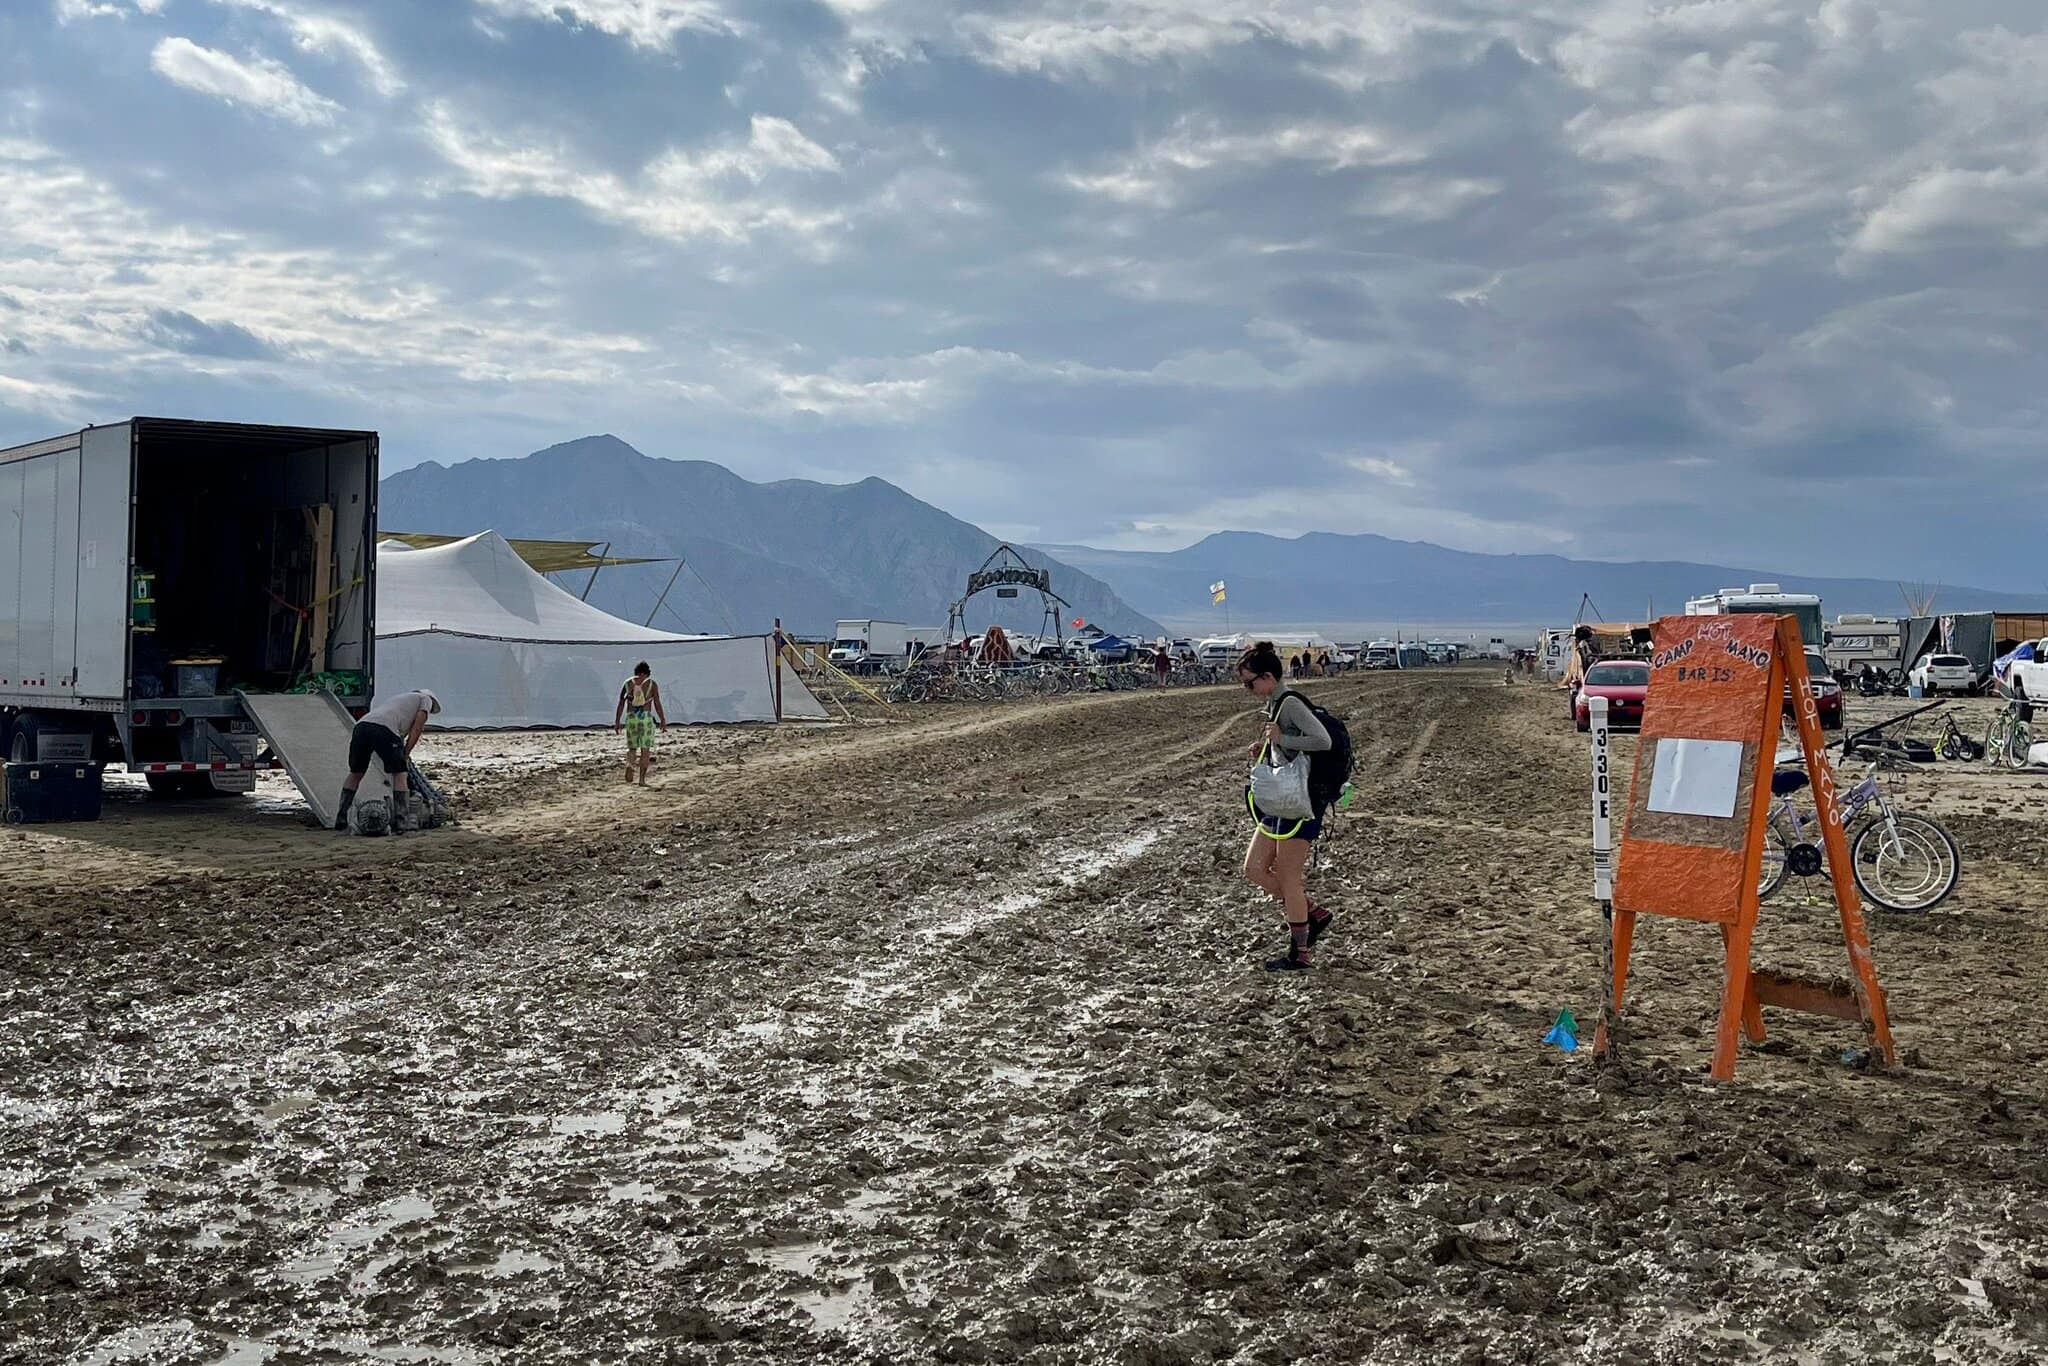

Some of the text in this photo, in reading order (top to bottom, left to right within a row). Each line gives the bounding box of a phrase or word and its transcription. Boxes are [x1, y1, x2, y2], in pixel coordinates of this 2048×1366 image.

[1653, 622, 1771, 669] CAMP HOT MAYO
[1678, 667, 1706, 681] BAR
[1798, 677, 1839, 826] HOT MAYO
[1600, 800, 1609, 818] E
